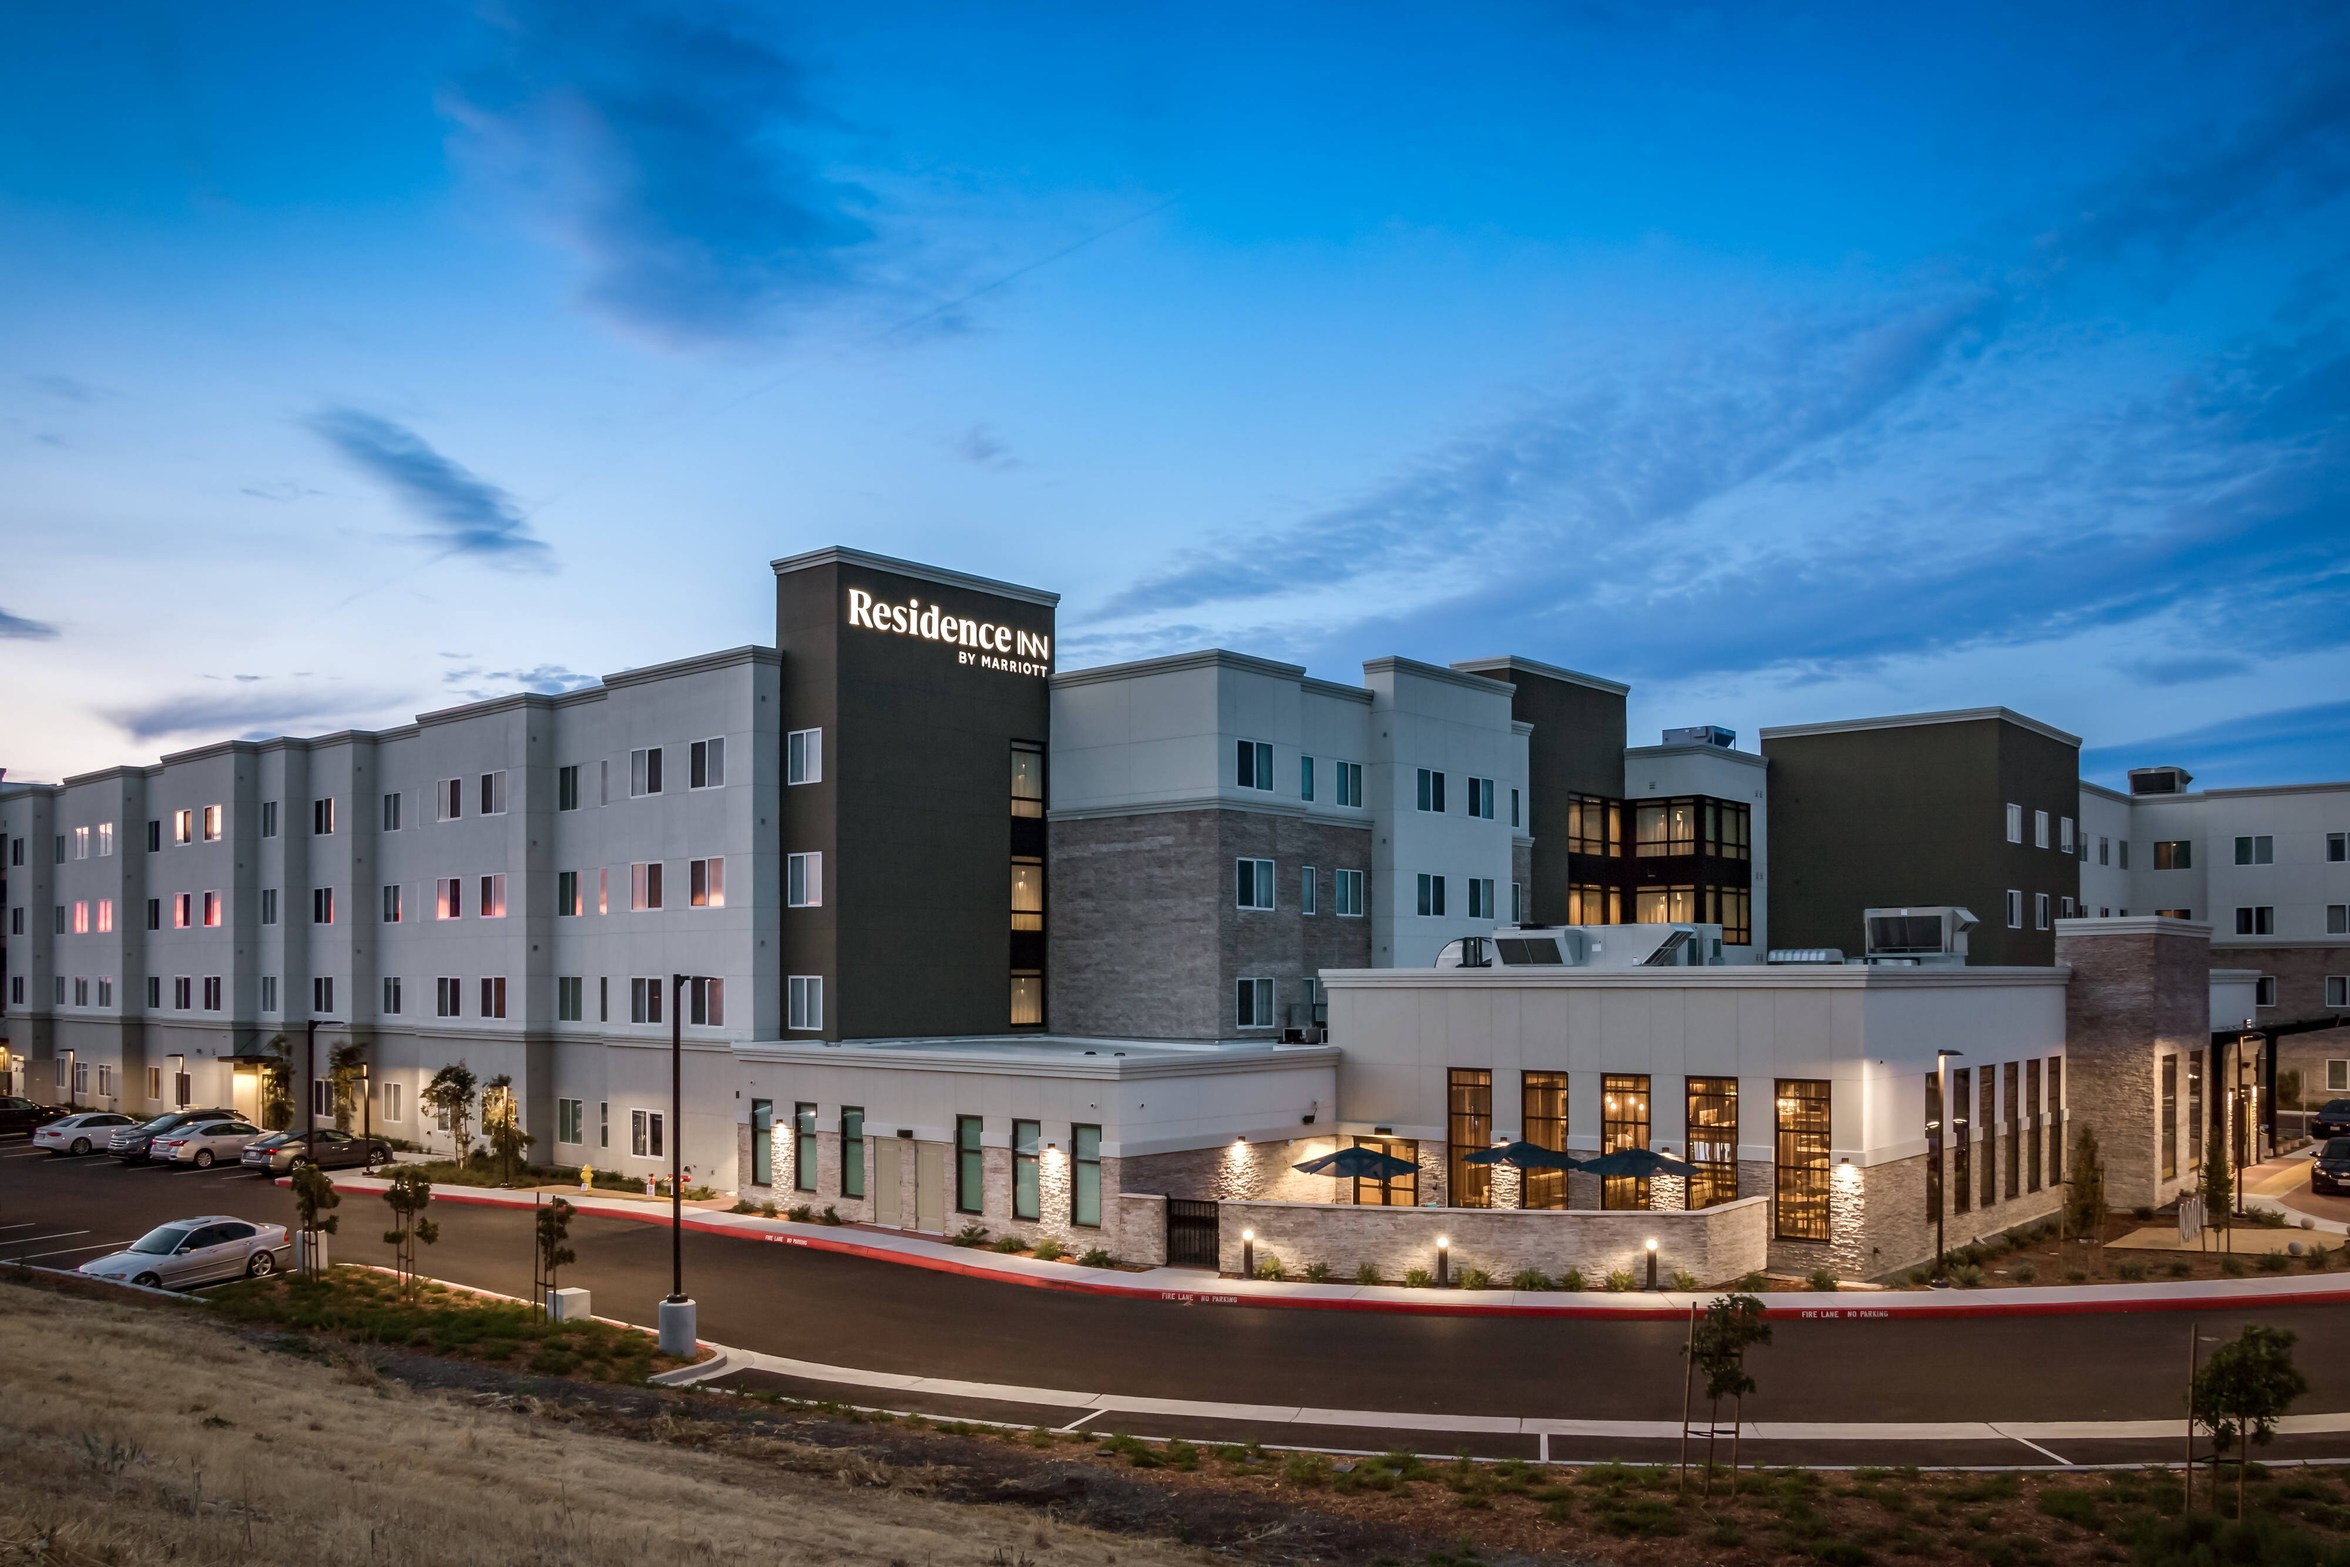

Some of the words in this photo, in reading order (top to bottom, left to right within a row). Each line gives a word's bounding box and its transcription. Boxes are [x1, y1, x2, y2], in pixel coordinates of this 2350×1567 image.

[848, 588, 1012, 653] Residence
[1016, 630, 1049, 661] INN
[958, 651, 976, 665] BY
[981, 655, 1048, 678] MARRIOTT
[1162, 1292, 1176, 1300] FIRE
[1801, 1310, 1818, 1318] FIRE
[1820, 1310, 1840, 1318] LANE
[1847, 1310, 1857, 1318] NO
[1860, 1310, 1889, 1318] PARKING
